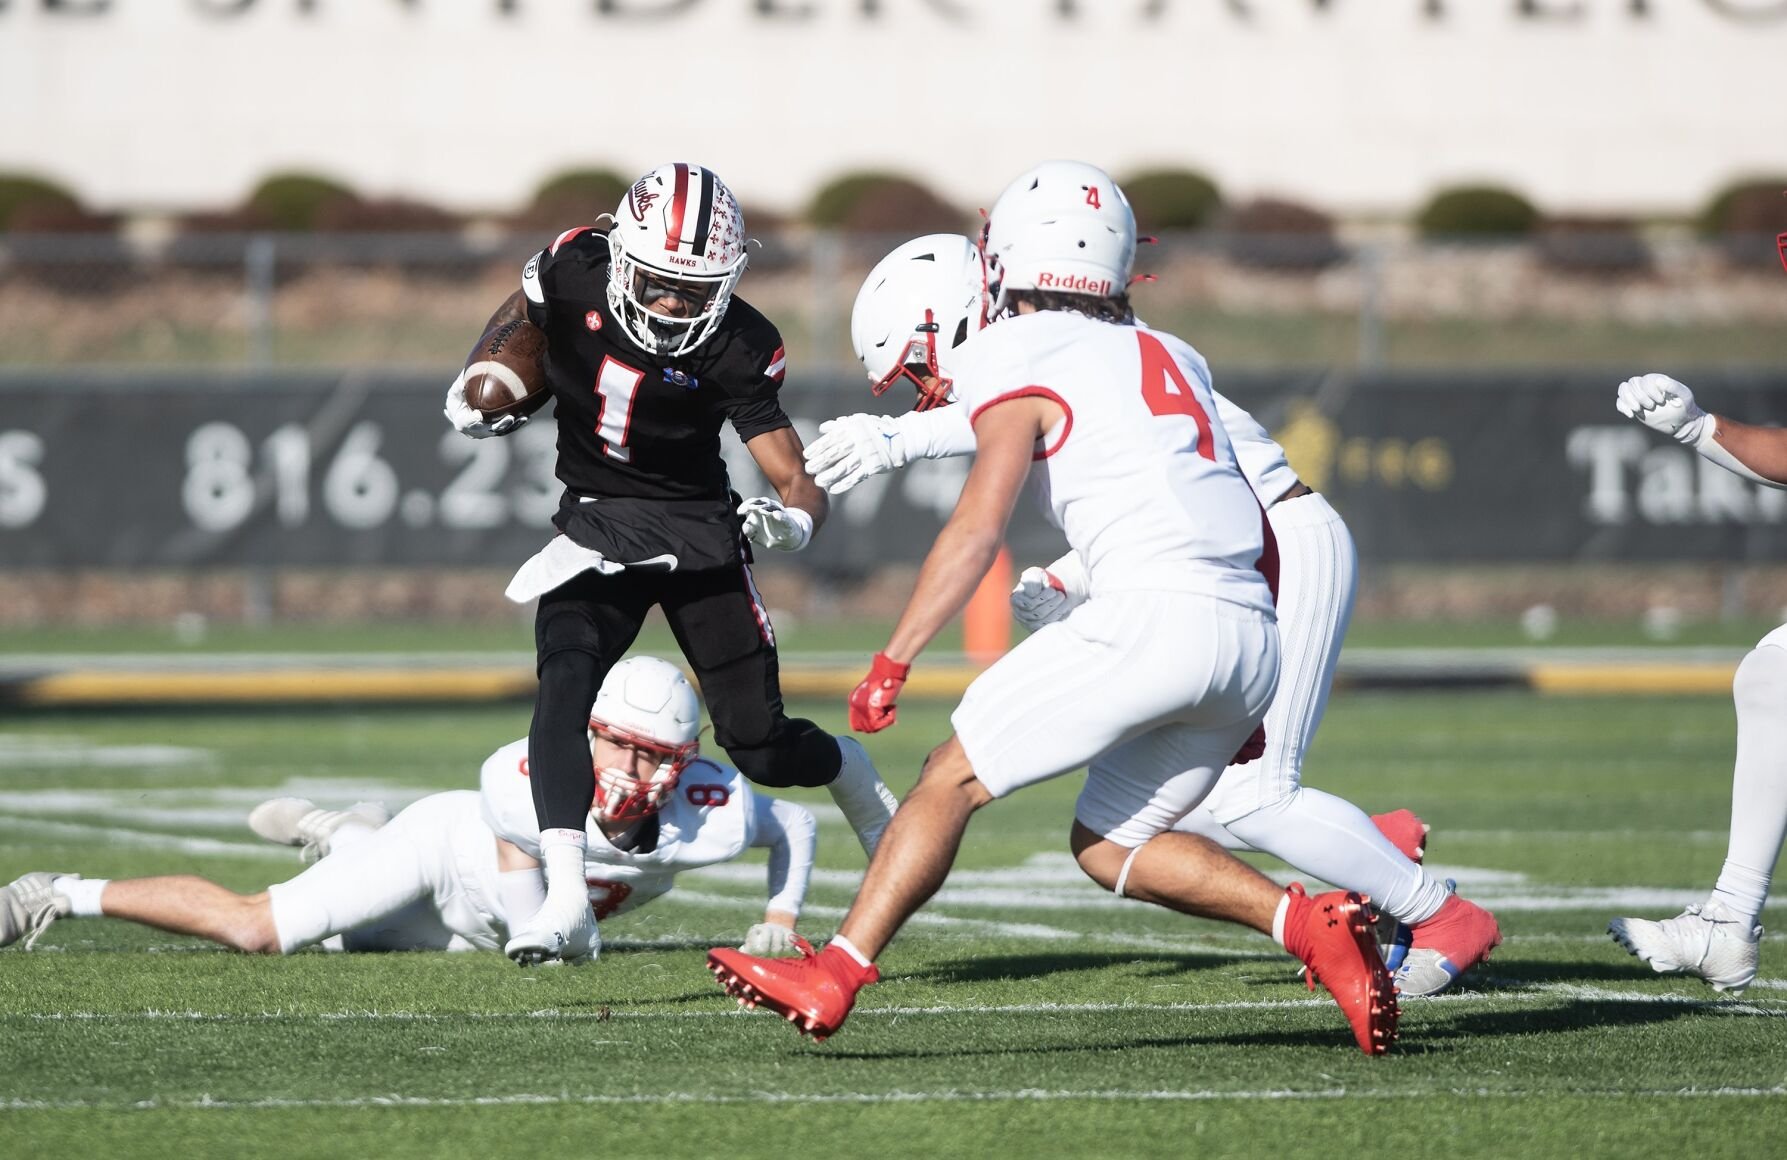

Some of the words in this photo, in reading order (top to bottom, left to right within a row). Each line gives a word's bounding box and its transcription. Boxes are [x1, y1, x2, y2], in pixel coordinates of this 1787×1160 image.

[1086, 187, 1101, 209] 4
[669, 256, 697, 267] HAWKS
[1038, 272, 1111, 297] Riddell
[594, 353, 645, 463] 1
[1136, 330, 1217, 461] 4
